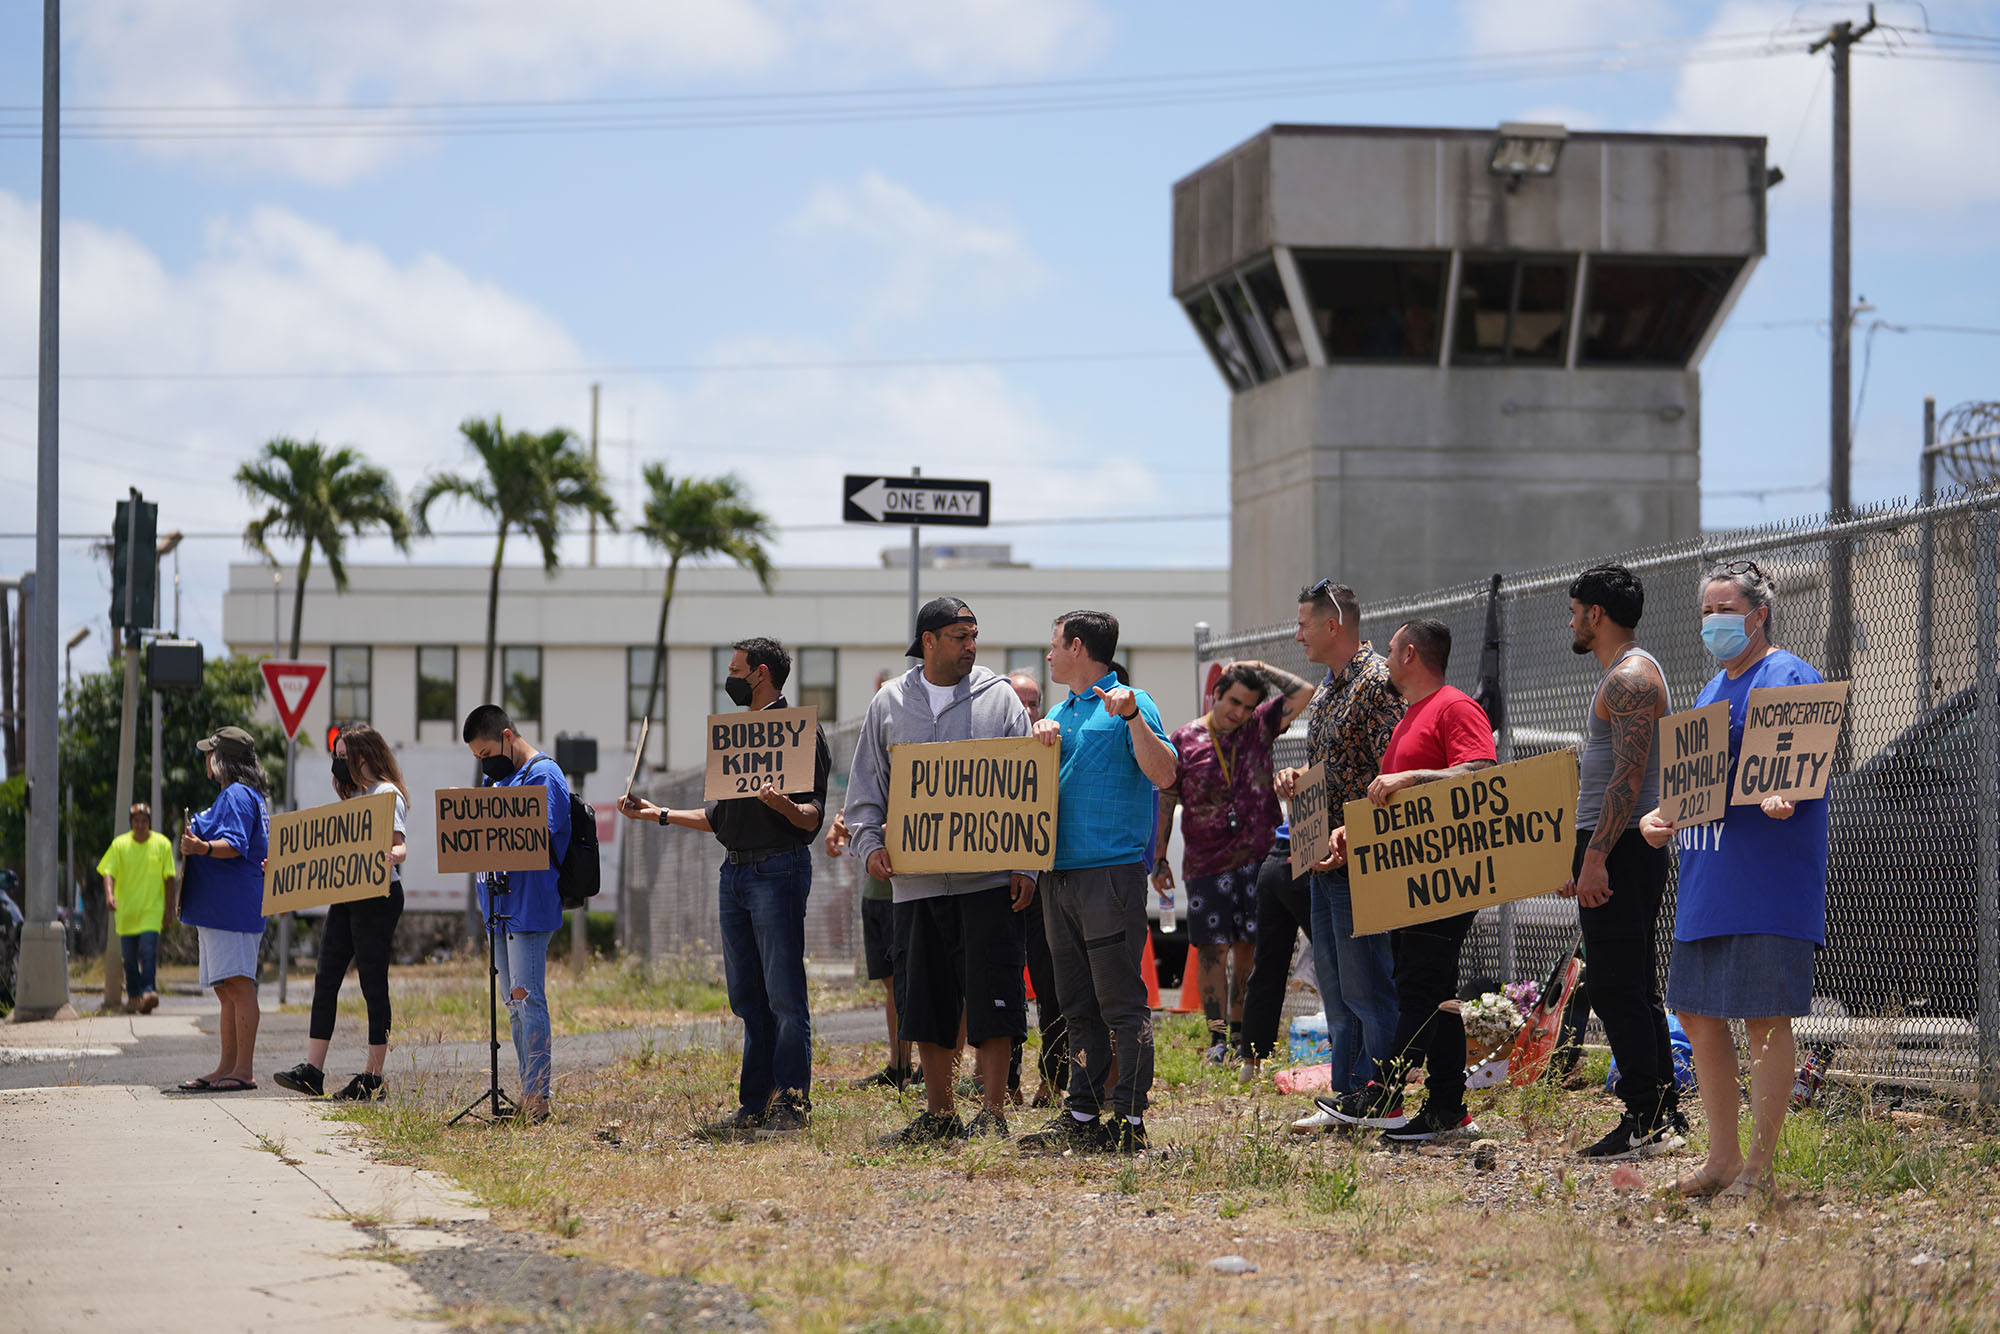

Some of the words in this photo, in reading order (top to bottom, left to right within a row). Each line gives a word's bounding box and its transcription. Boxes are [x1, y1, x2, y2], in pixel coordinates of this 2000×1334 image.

[886, 491, 925, 511] ONE
[932, 492, 974, 512] WAY
[712, 719, 806, 750] BOBBY
[1750, 701, 1842, 729] INCARCERATED
[1675, 717, 1709, 760] NOA
[722, 750, 783, 775] KIMI
[1663, 751, 1726, 799] MAMALA
[1741, 752, 1828, 796] GUILTY
[1289, 778, 1327, 828] JOSEPH
[1373, 796, 1434, 835] DEAR
[1450, 776, 1509, 820] DPS
[1677, 790, 1711, 822] 2021
[441, 828, 483, 853] NOT
[486, 826, 547, 852] PRISON
[902, 812, 944, 852] NOT
[949, 810, 1051, 857] PRISONS
[1299, 842, 1315, 868] 2017
[1354, 808, 1564, 875] TRANSPARENCY
[272, 862, 306, 896] NOT
[307, 850, 387, 890] PRISONS
[1407, 856, 1497, 909] NOW!
